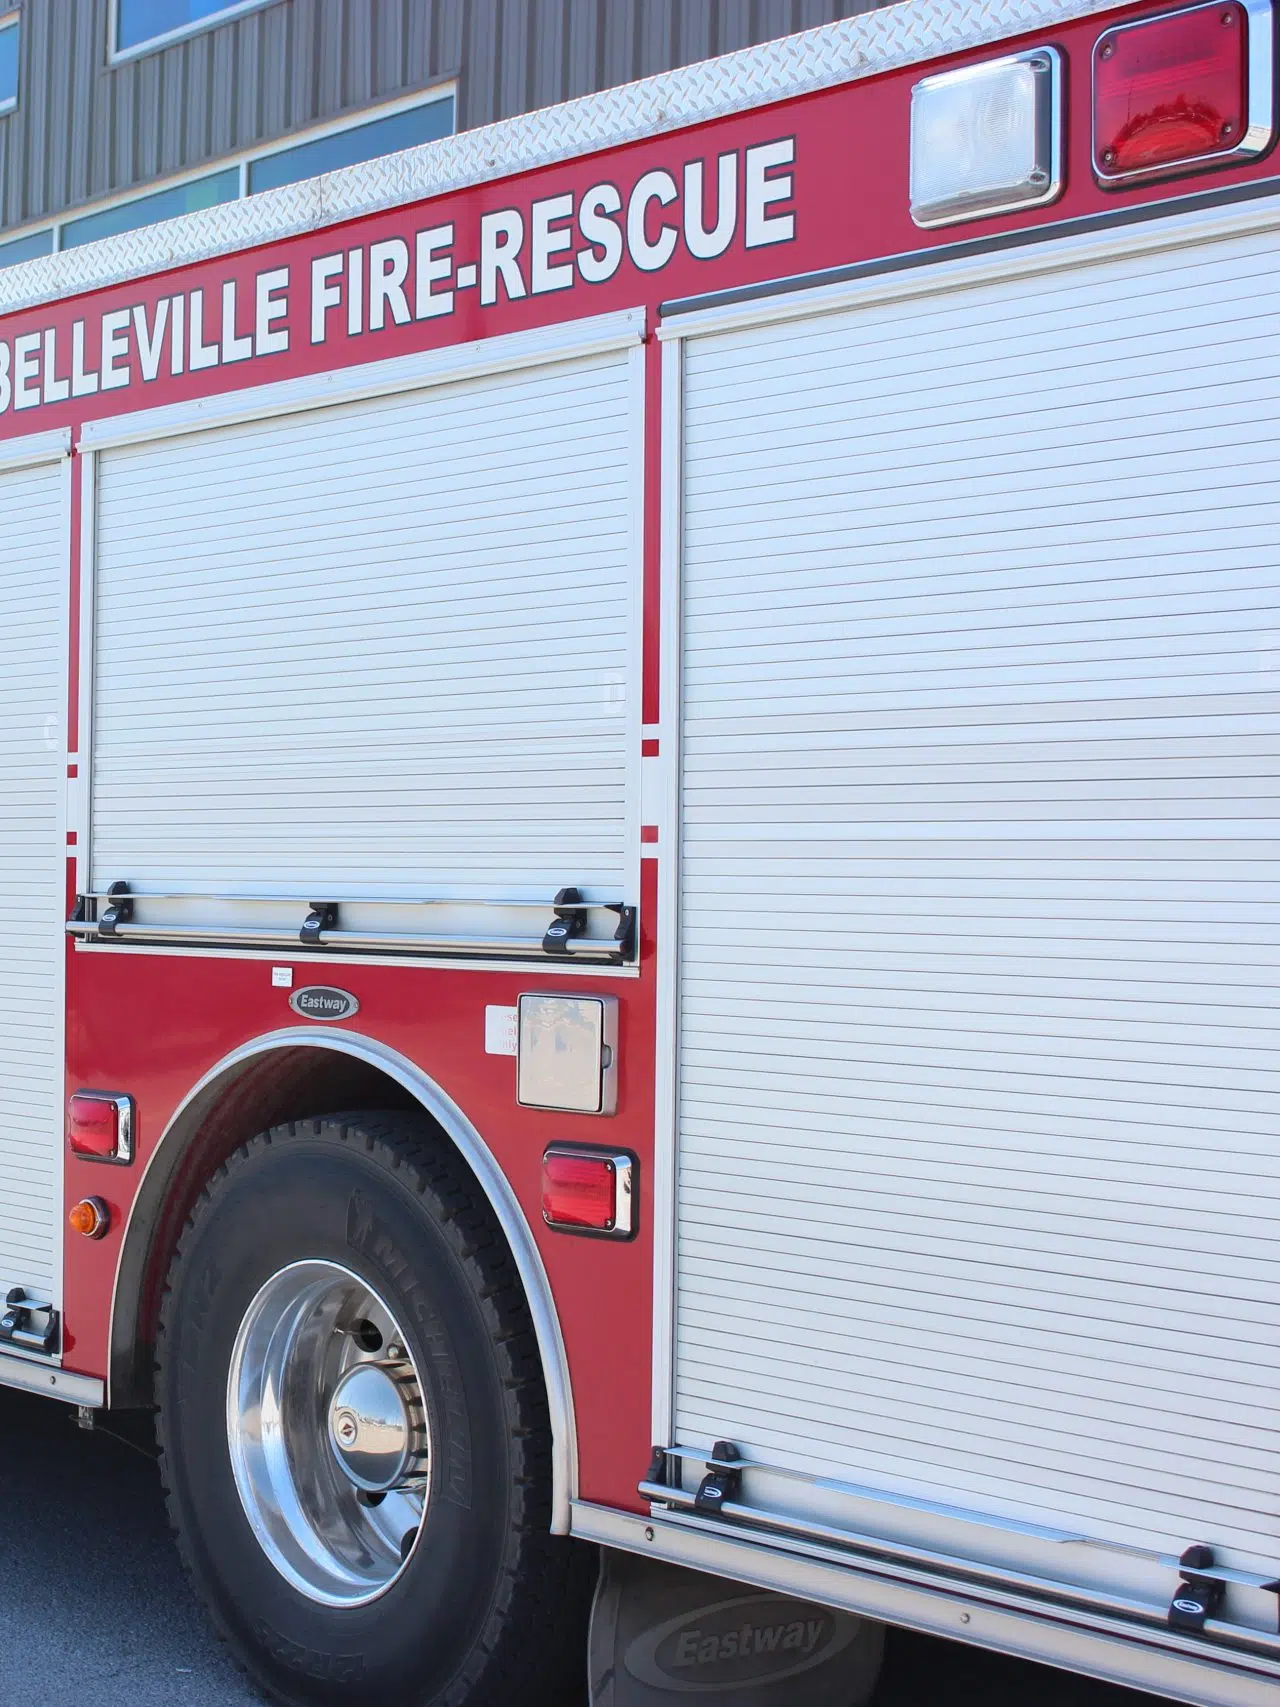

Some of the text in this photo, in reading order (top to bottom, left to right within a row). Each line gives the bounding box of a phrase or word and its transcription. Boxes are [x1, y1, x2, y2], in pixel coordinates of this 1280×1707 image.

[310, 134, 797, 346] FIRE-RESCUE
[300, 994, 347, 1013] Eastway
[672, 1618, 825, 1668] Eastway
